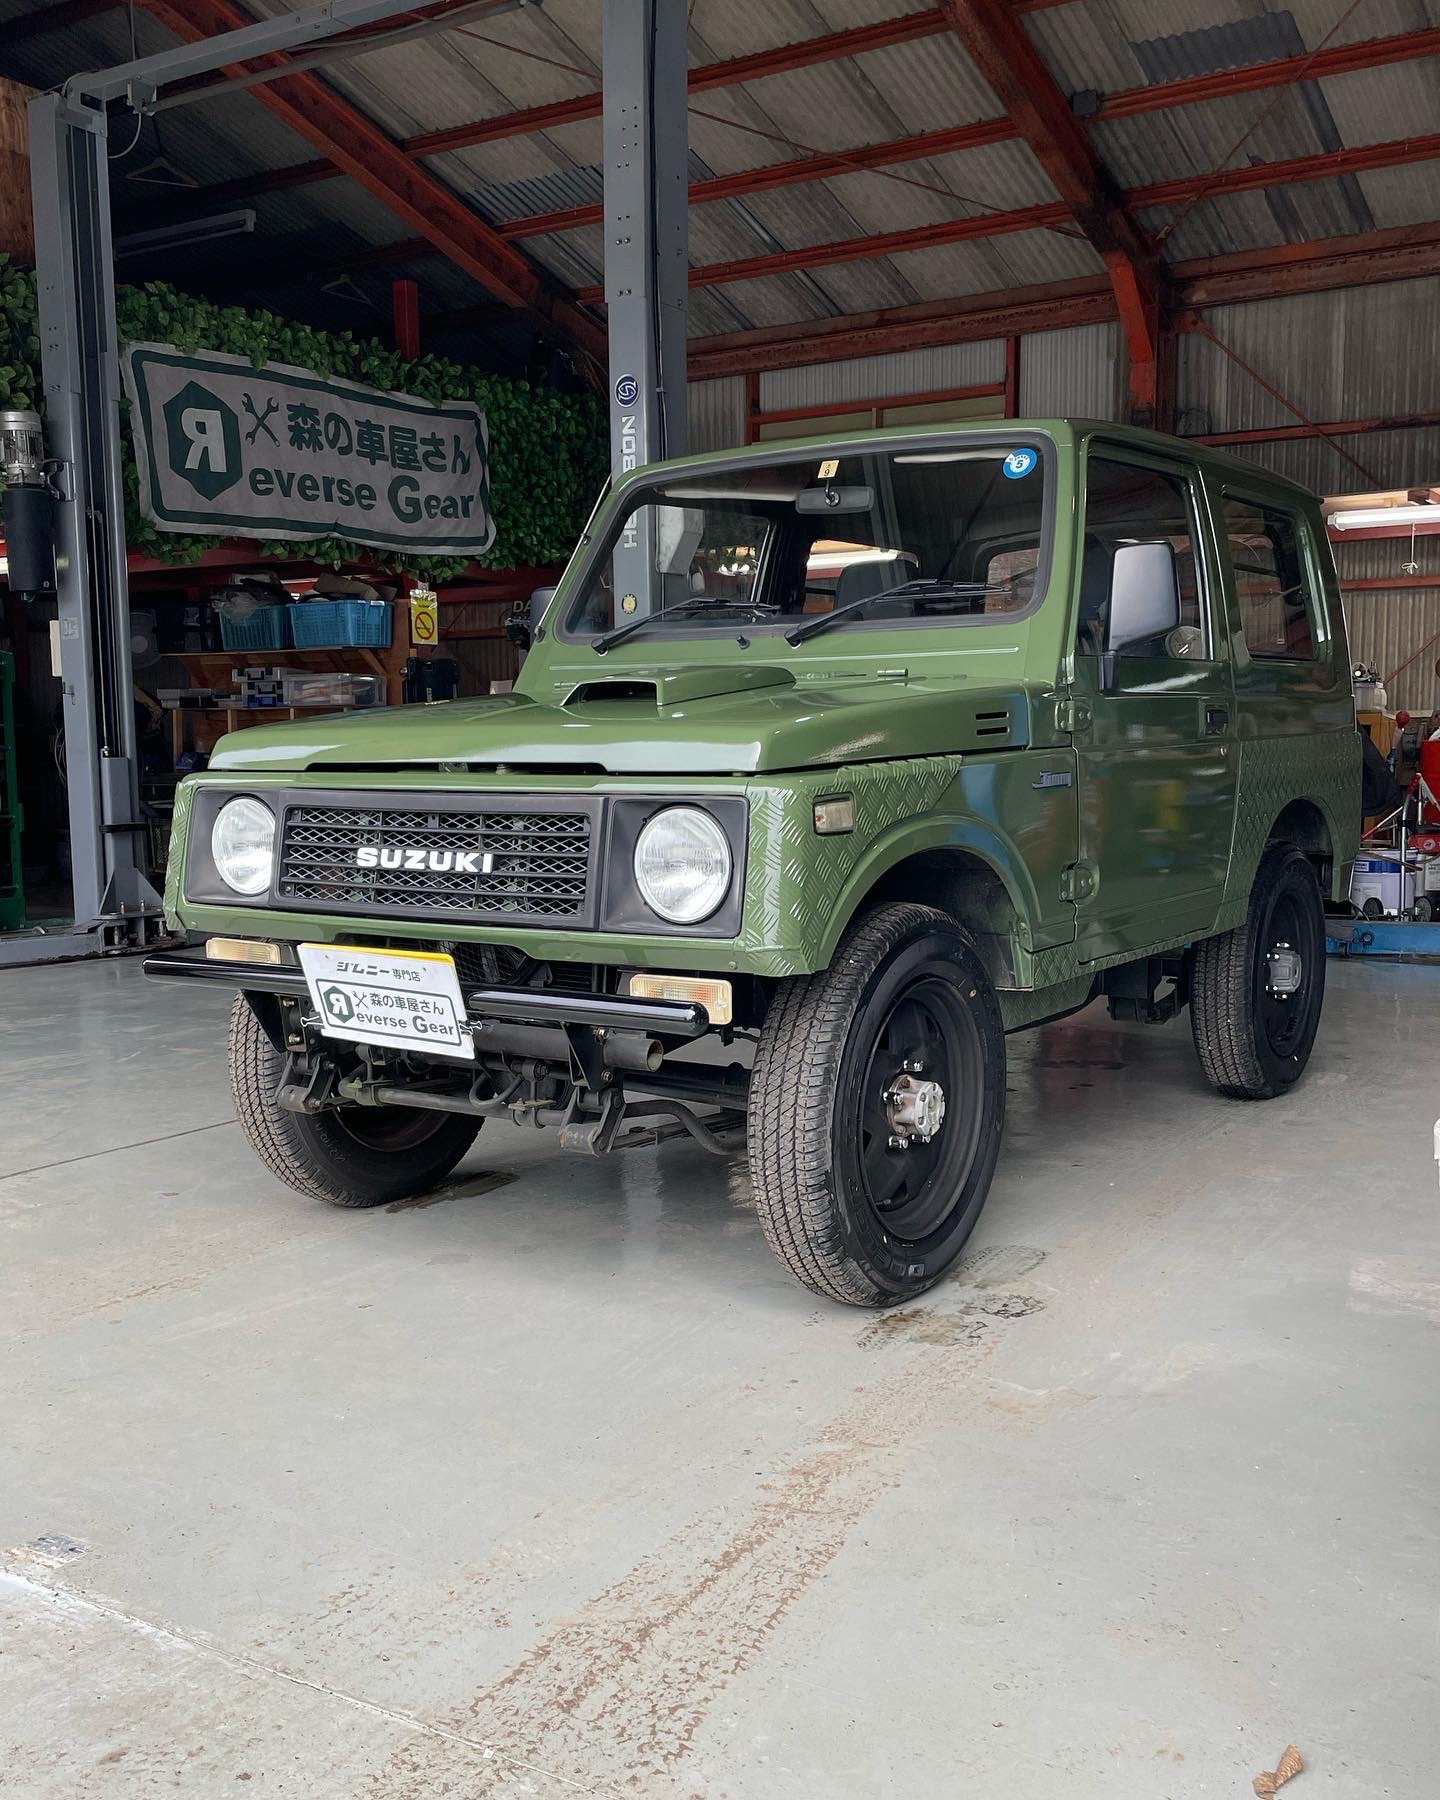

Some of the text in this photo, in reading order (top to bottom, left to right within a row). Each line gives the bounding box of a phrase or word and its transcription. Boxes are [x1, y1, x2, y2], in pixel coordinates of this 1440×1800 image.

[286, 402, 471, 475] 森の車屋さん
[1015, 459, 1024, 469] 5
[248, 466, 475, 524] everse Gear
[356, 847, 494, 874] SUZUKI
[370, 992, 444, 1015] 森の車屋さん
[356, 1011, 456, 1035] everse Gear
